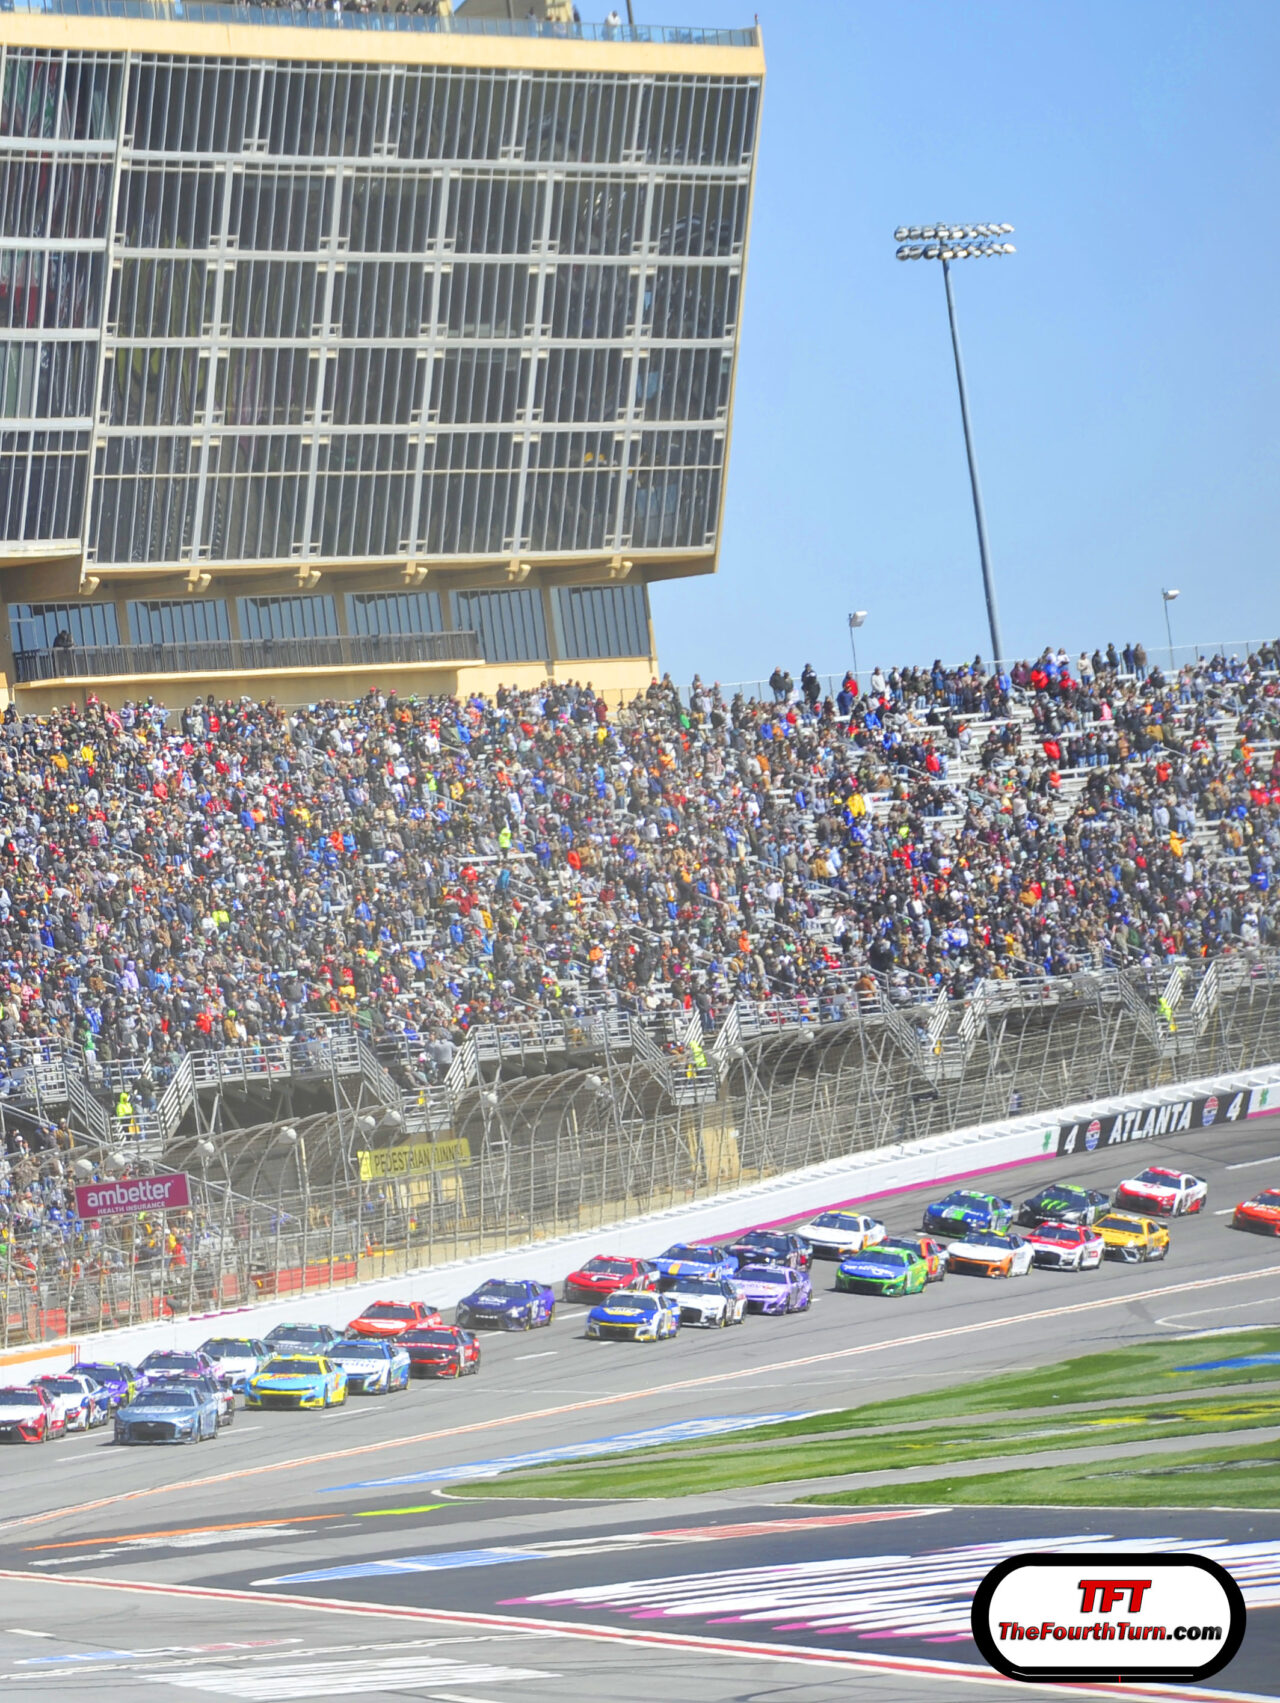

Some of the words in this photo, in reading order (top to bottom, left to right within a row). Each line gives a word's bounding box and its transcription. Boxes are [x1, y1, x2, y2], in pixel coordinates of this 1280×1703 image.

[1064, 1124, 1079, 1154] 4
[1108, 1101, 1193, 1145] ATLANTA
[1226, 1092, 1244, 1121] 4
[374, 1148, 430, 1173] PEDESTRIAN
[87, 1180, 172, 1208] ambetter
[97, 1206, 125, 1215] HEALTH
[125, 1201, 165, 1212] INSURANCE
